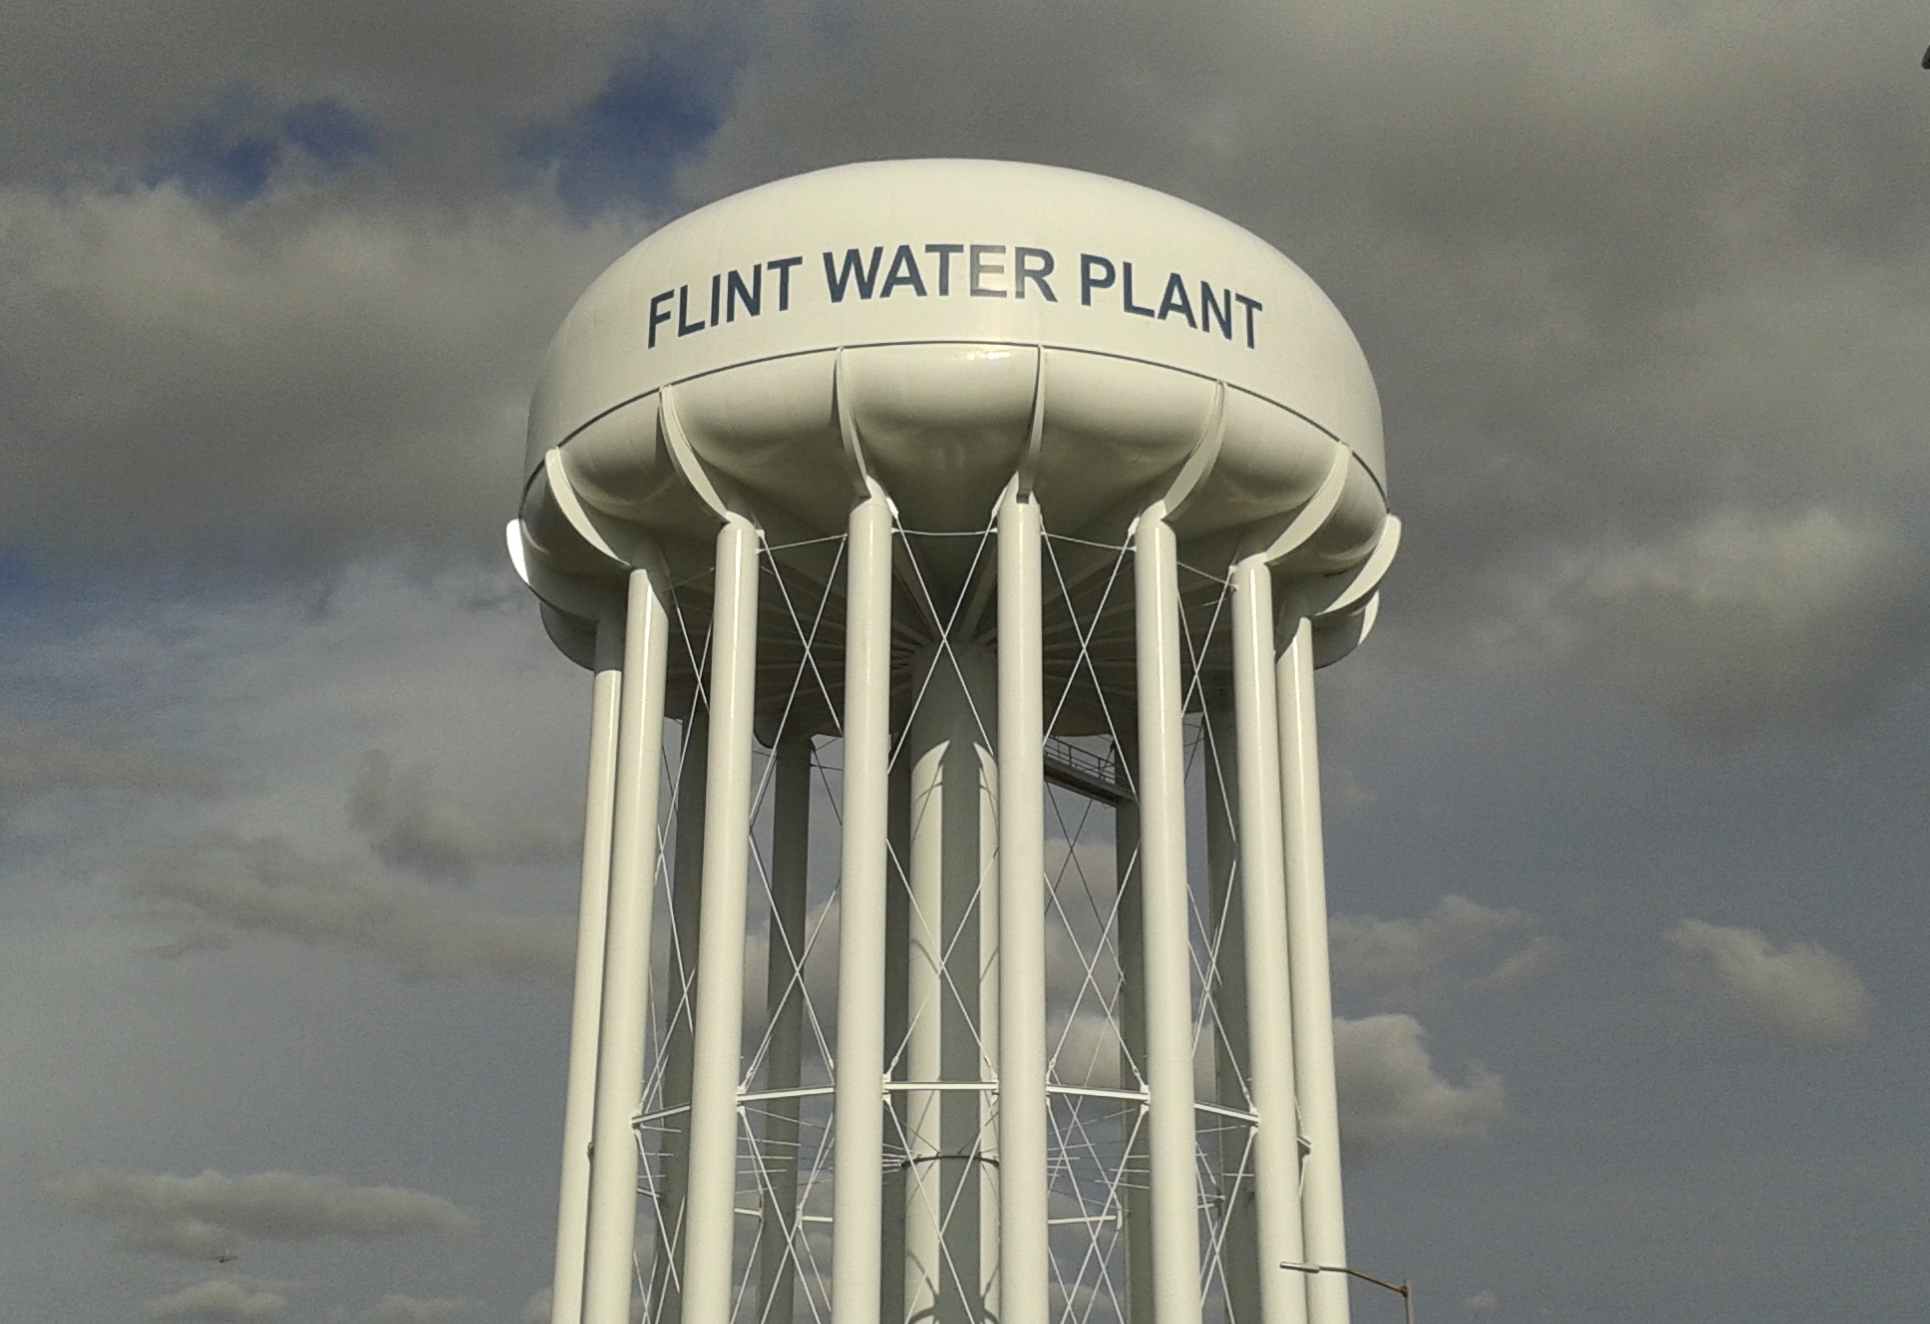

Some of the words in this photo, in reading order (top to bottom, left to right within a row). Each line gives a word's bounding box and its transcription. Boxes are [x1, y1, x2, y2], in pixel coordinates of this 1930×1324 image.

[648, 256, 803, 349] FLINT
[822, 244, 1058, 303] WATER
[1080, 253, 1263, 350] PLANT
